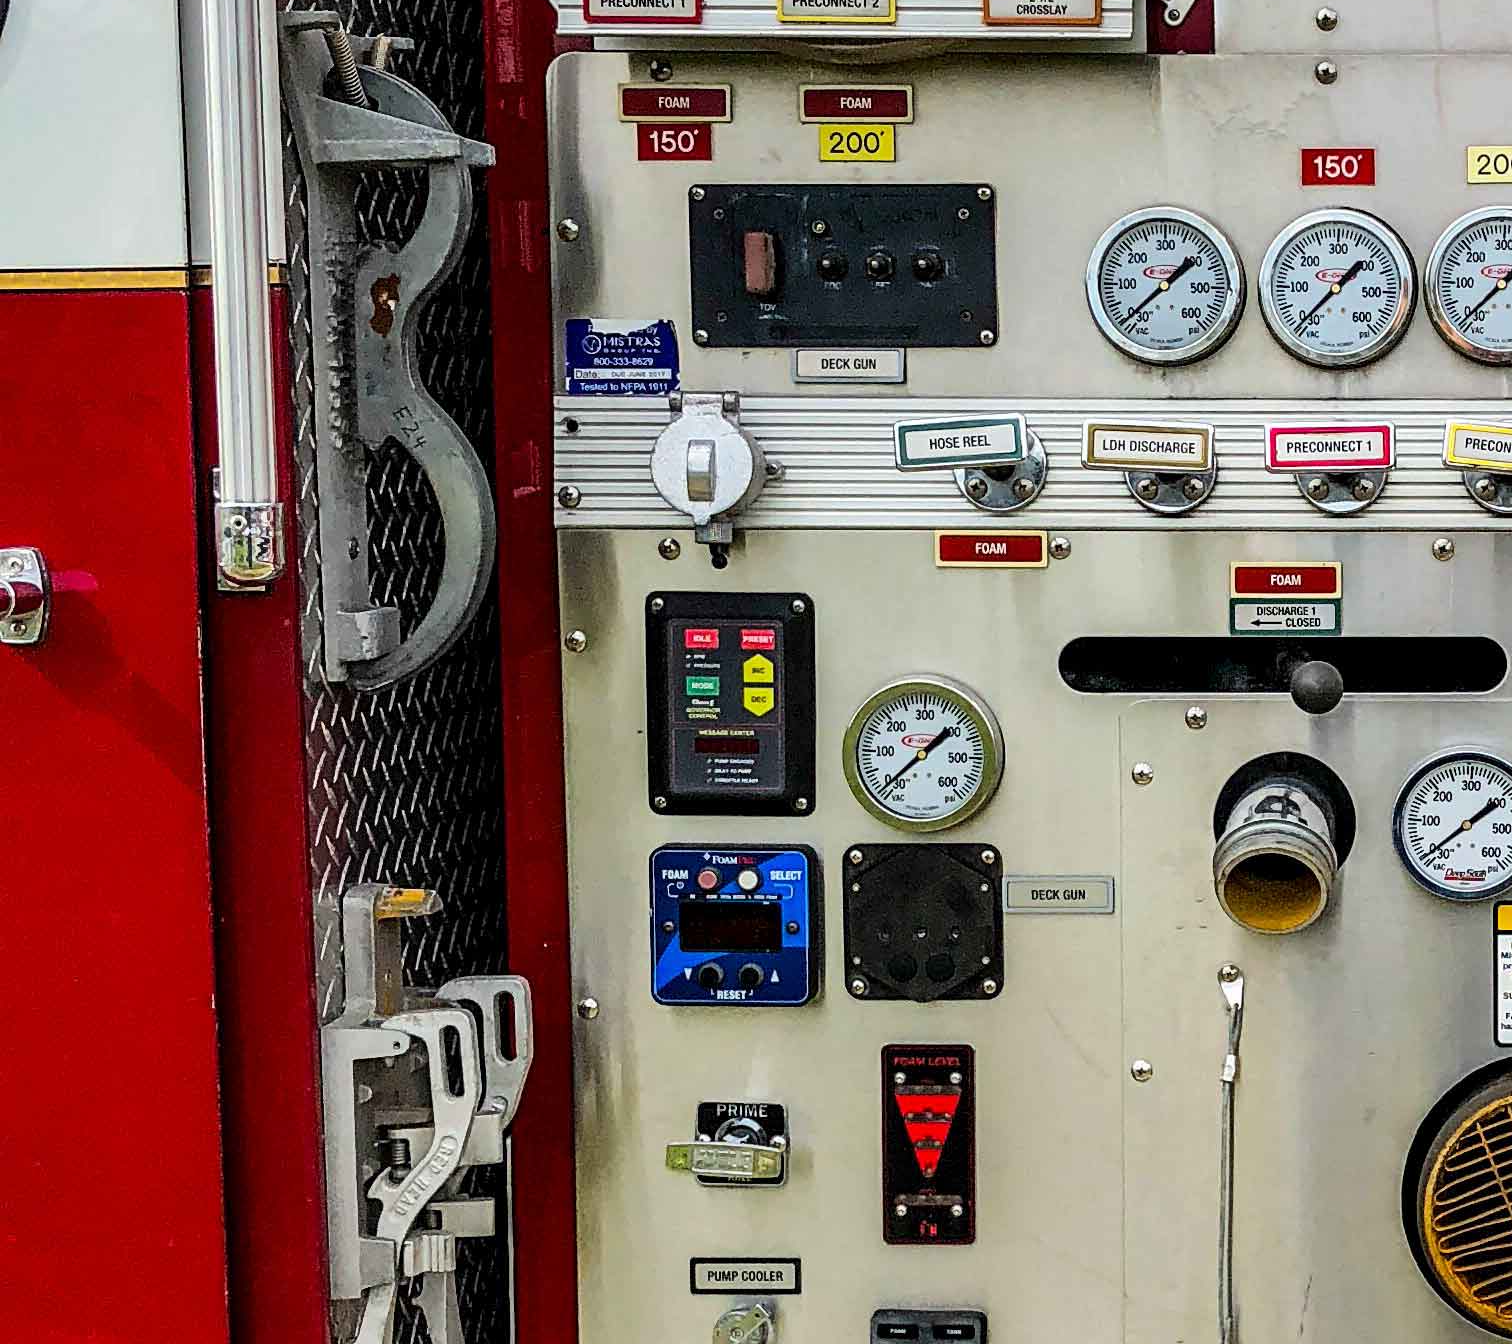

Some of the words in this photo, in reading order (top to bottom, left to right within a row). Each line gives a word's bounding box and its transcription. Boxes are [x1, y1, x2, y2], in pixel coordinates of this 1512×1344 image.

[1016, 3, 1068, 16] CROSSLAY
[658, 96, 690, 110] FOAM
[840, 96, 873, 110] FOAM
[1155, 239, 1176, 252] 300
[1328, 243, 1349, 256] 300
[603, 336, 661, 346] MISTRAS
[821, 358, 851, 370] DECK
[853, 358, 876, 370] GUN
[929, 435, 958, 449] HOSE
[962, 433, 991, 448] REEL
[1286, 440, 1362, 454] PRECONNECT
[1365, 440, 1372, 452] 1
[1102, 439, 1126, 454] LDH
[1129, 440, 1195, 457] DISCHARGE
[975, 542, 1007, 556] FOAM
[1270, 573, 1302, 587] FOAM
[1256, 606, 1308, 618] DISCHARGE
[1311, 606, 1317, 617] 1
[1285, 616, 1321, 628] CLOSED
[915, 709, 935, 721] 300
[1461, 780, 1481, 792] 300
[1481, 847, 1501, 858] 600
[662, 870, 689, 880] FOAM
[770, 870, 802, 881] SELECT
[1031, 889, 1060, 901] DECK
[1063, 889, 1086, 901] GUN
[717, 990, 747, 1000] RESET
[716, 1104, 768, 1118] PRIME
[707, 1271, 739, 1282] PUMP
[741, 1271, 784, 1282] COOLER
